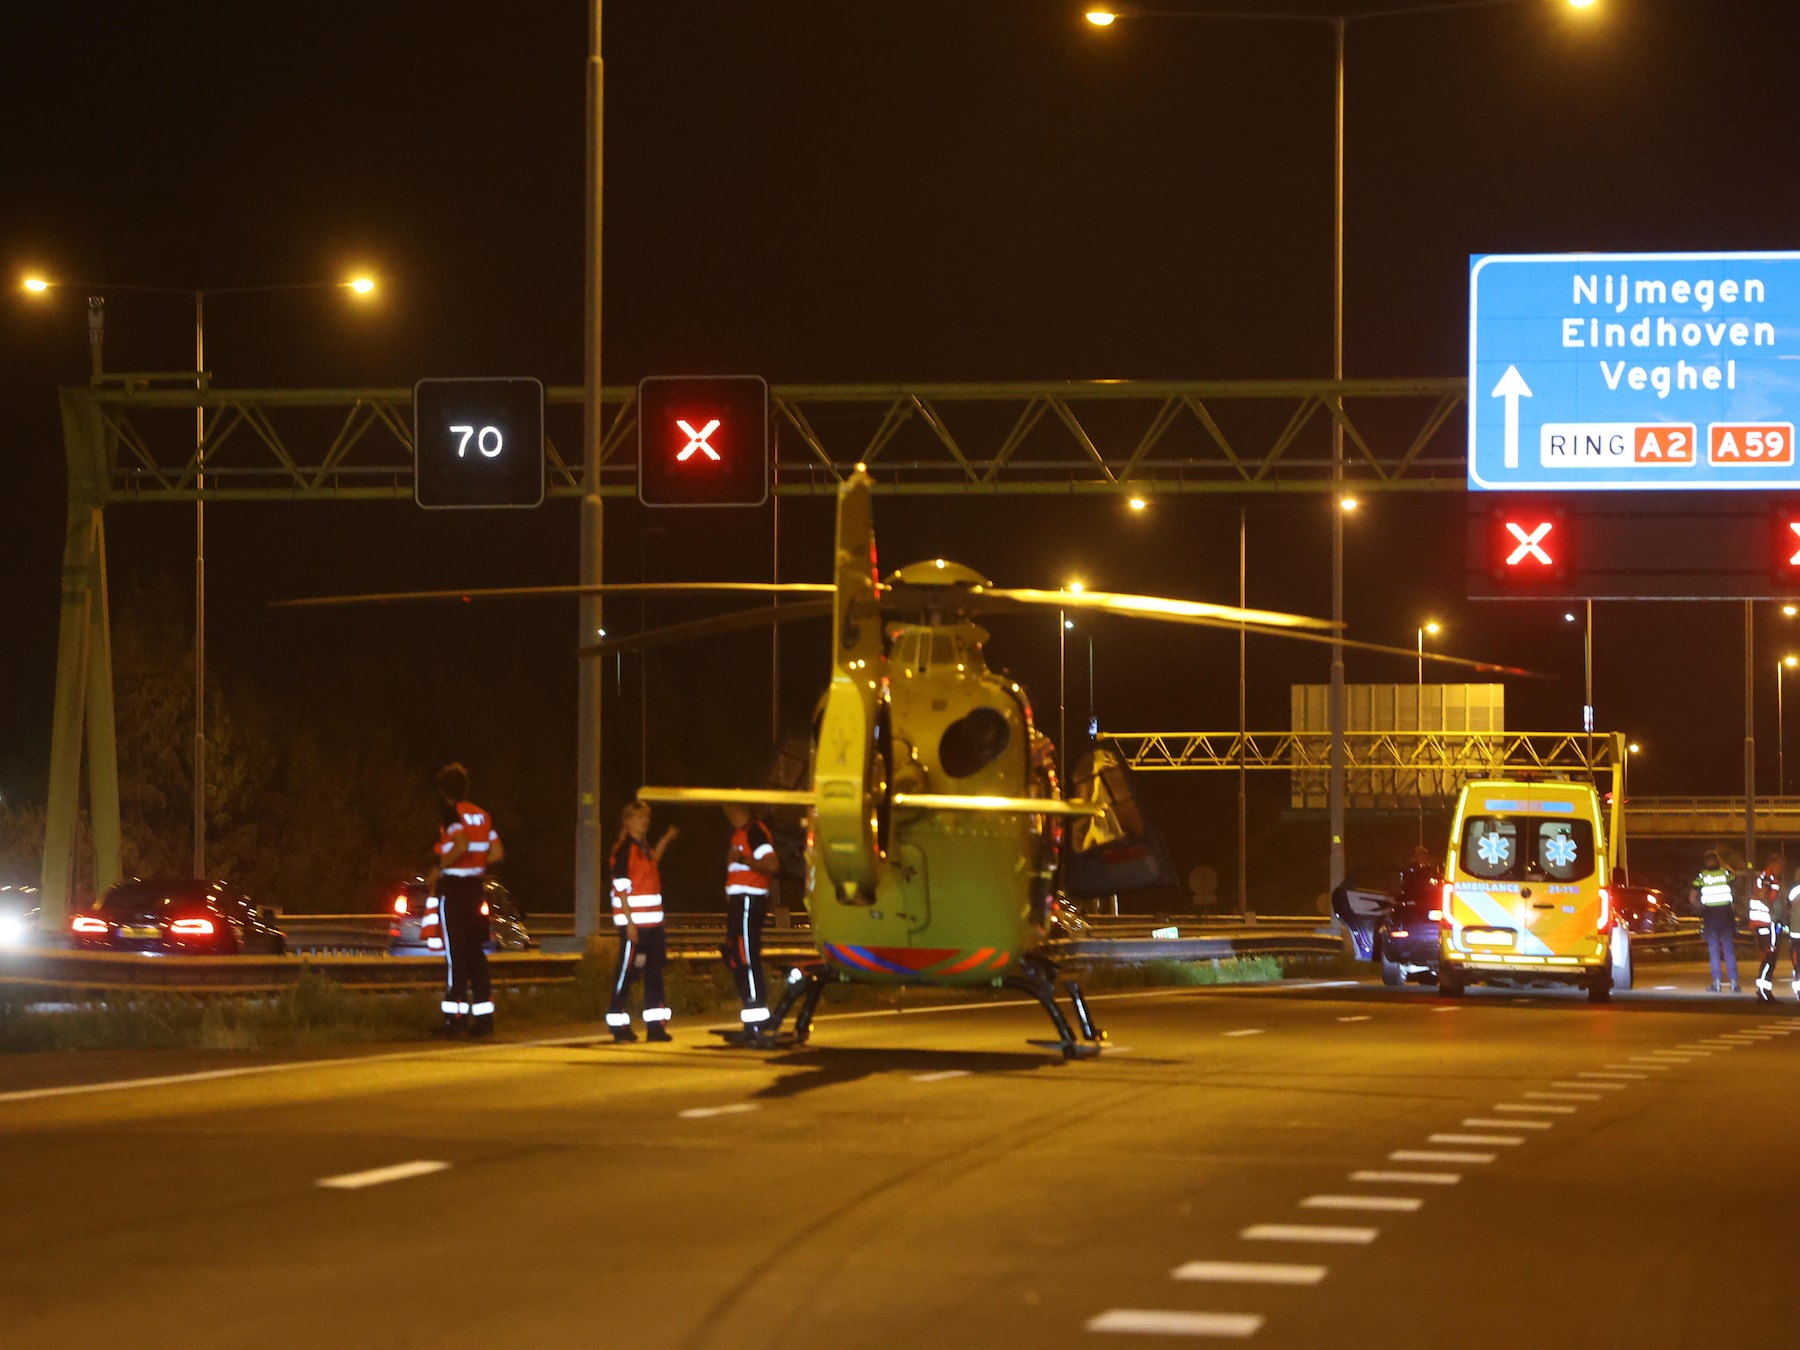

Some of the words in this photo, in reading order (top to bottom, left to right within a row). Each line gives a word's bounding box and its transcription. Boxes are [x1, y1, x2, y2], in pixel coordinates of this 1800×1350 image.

[1573, 274, 1765, 313] Nijmegen
[1562, 316, 1775, 348] Eindhoven
[1599, 359, 1736, 400] Veghel
[449, 425, 503, 458] 70
[1550, 434, 1625, 456] RING
[1639, 431, 1687, 458] A2
[1717, 431, 1785, 458] A59
[1454, 882, 1520, 893] AMBULANCE
